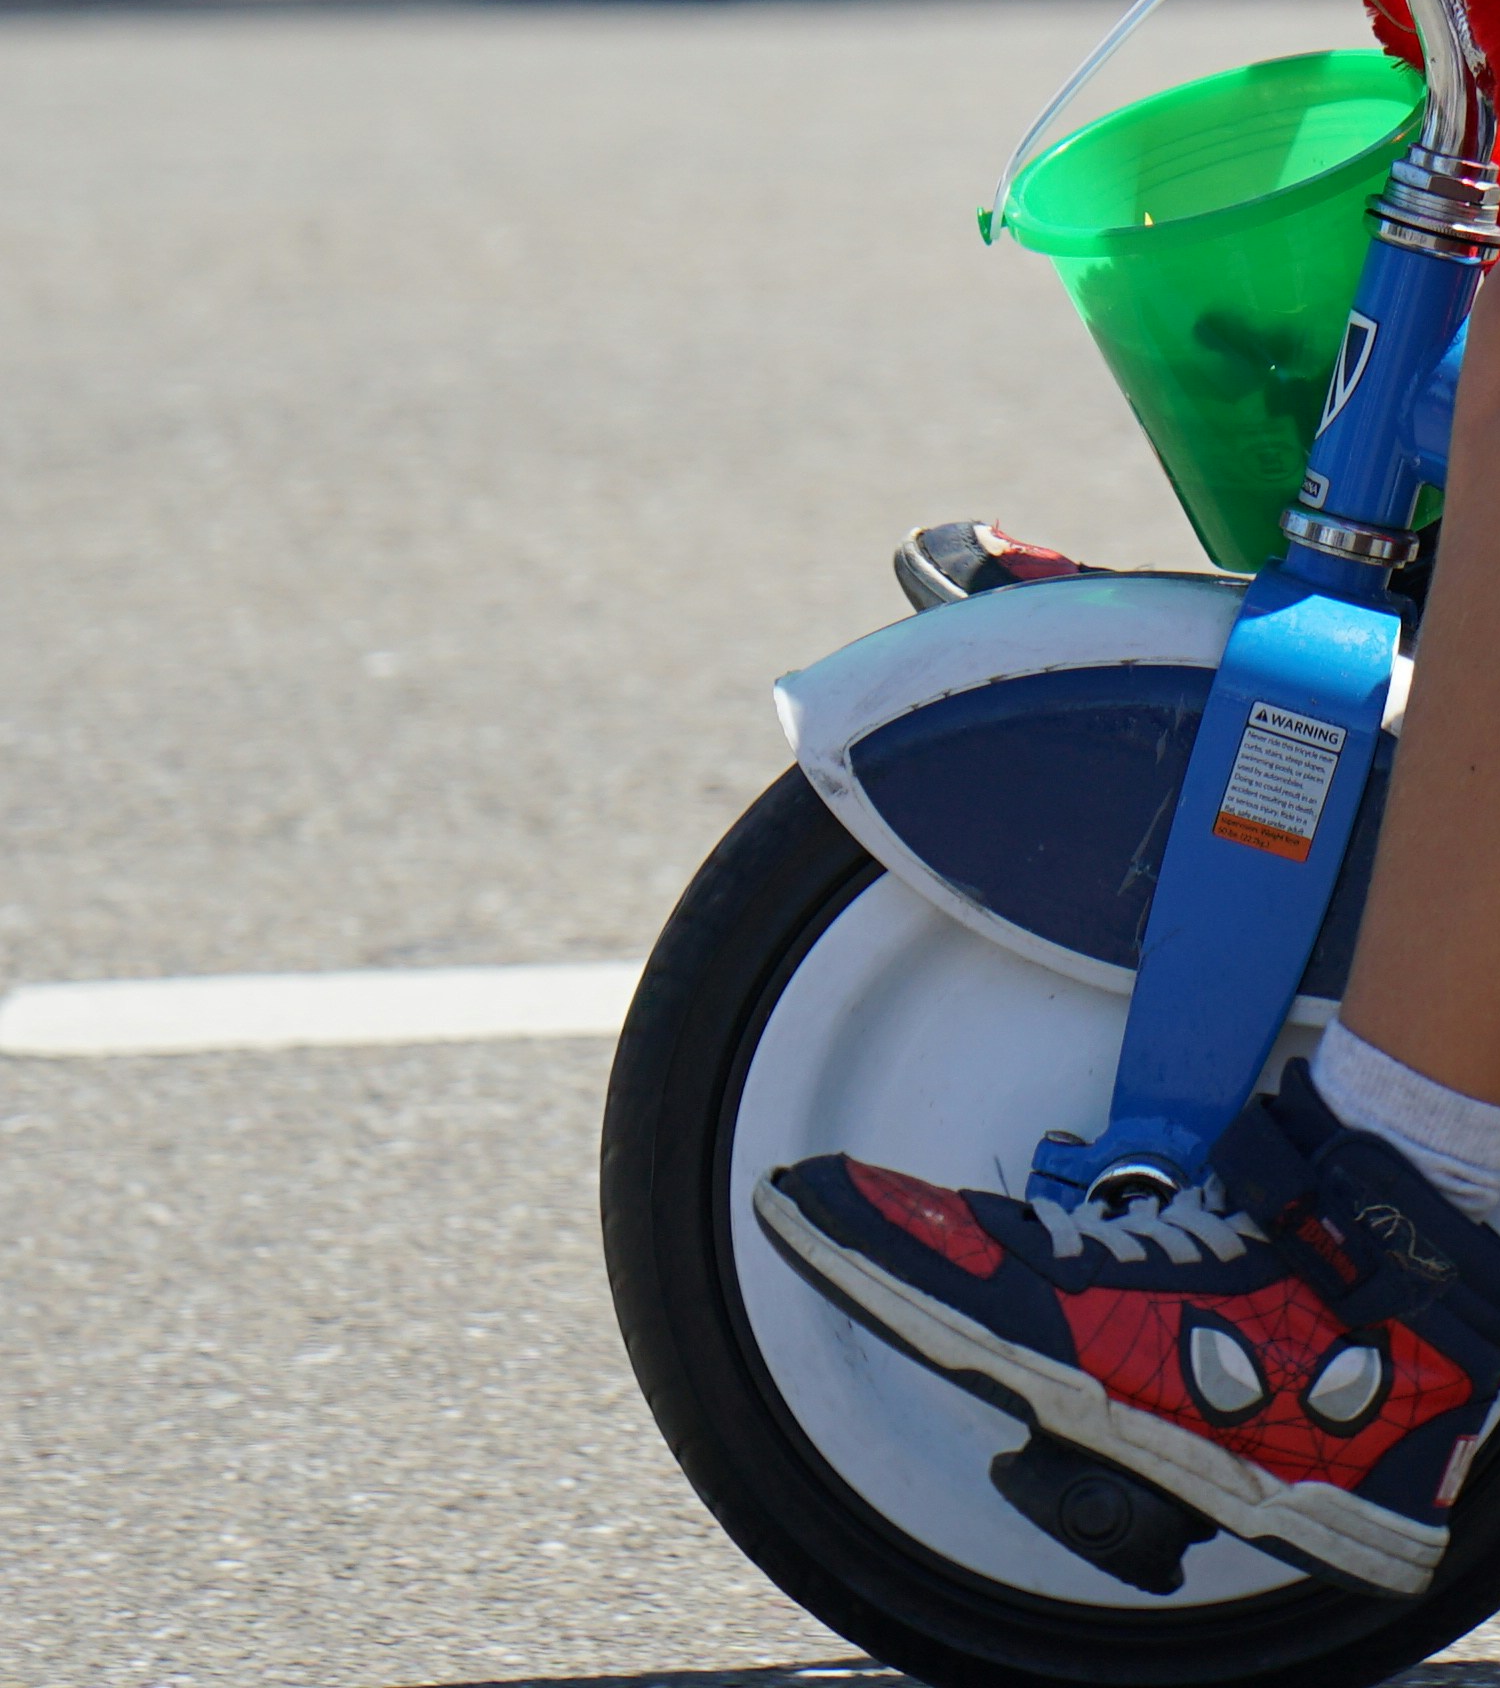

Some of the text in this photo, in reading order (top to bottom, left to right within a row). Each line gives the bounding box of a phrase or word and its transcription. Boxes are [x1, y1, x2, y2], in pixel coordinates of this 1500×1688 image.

[1269, 714, 1339, 744] WARNING
[1246, 730, 1267, 742] Never
[1267, 737, 1281, 747] ride
[1281, 741, 1293, 751] this
[1293, 745, 1318, 760] tricycle
[1237, 762, 1254, 773] used
[1253, 766, 1263, 777] by
[1240, 752, 1274, 768] swimming
[1233, 772, 1254, 786] Doing
[1262, 781, 1282, 794] could
[1230, 783, 1258, 797] accident
[1258, 792, 1287, 808] resulting
[1287, 801, 1295, 809] in
[1235, 797, 1259, 809] serious
